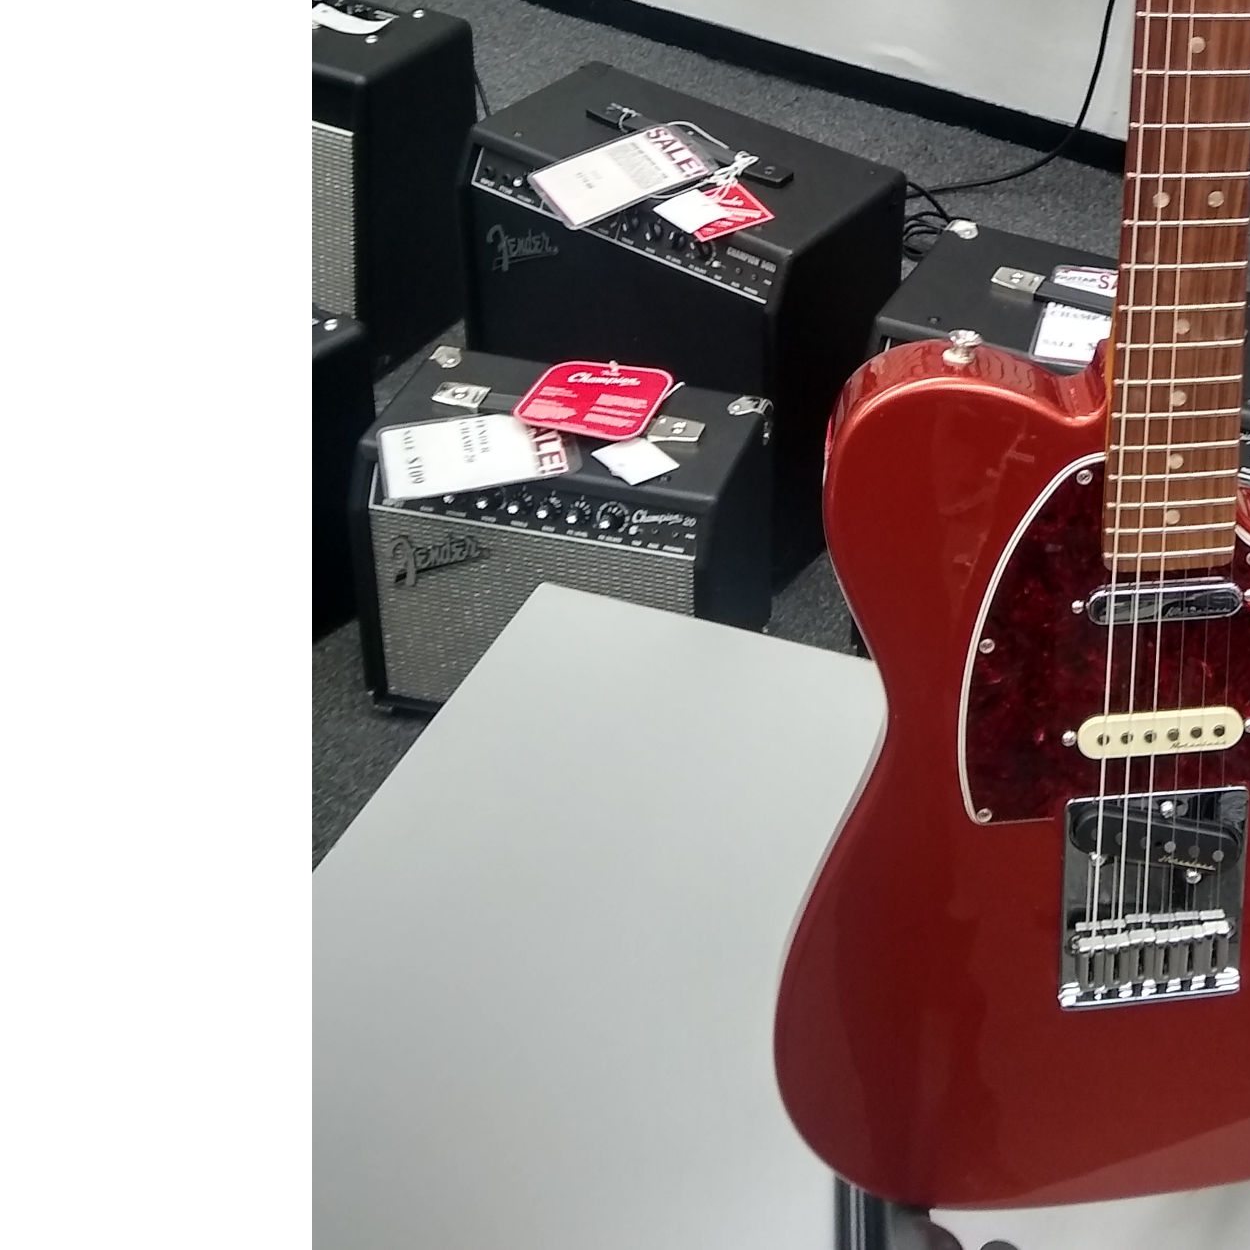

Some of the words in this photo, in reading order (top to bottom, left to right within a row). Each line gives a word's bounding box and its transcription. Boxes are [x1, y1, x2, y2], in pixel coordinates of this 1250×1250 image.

[648, 127, 710, 178] SALE!
[486, 224, 559, 272] Fender
[567, 371, 641, 387] Champion
[532, 427, 569, 474] ALE!
[631, 509, 683, 525] Champion
[682, 517, 697, 528] 20
